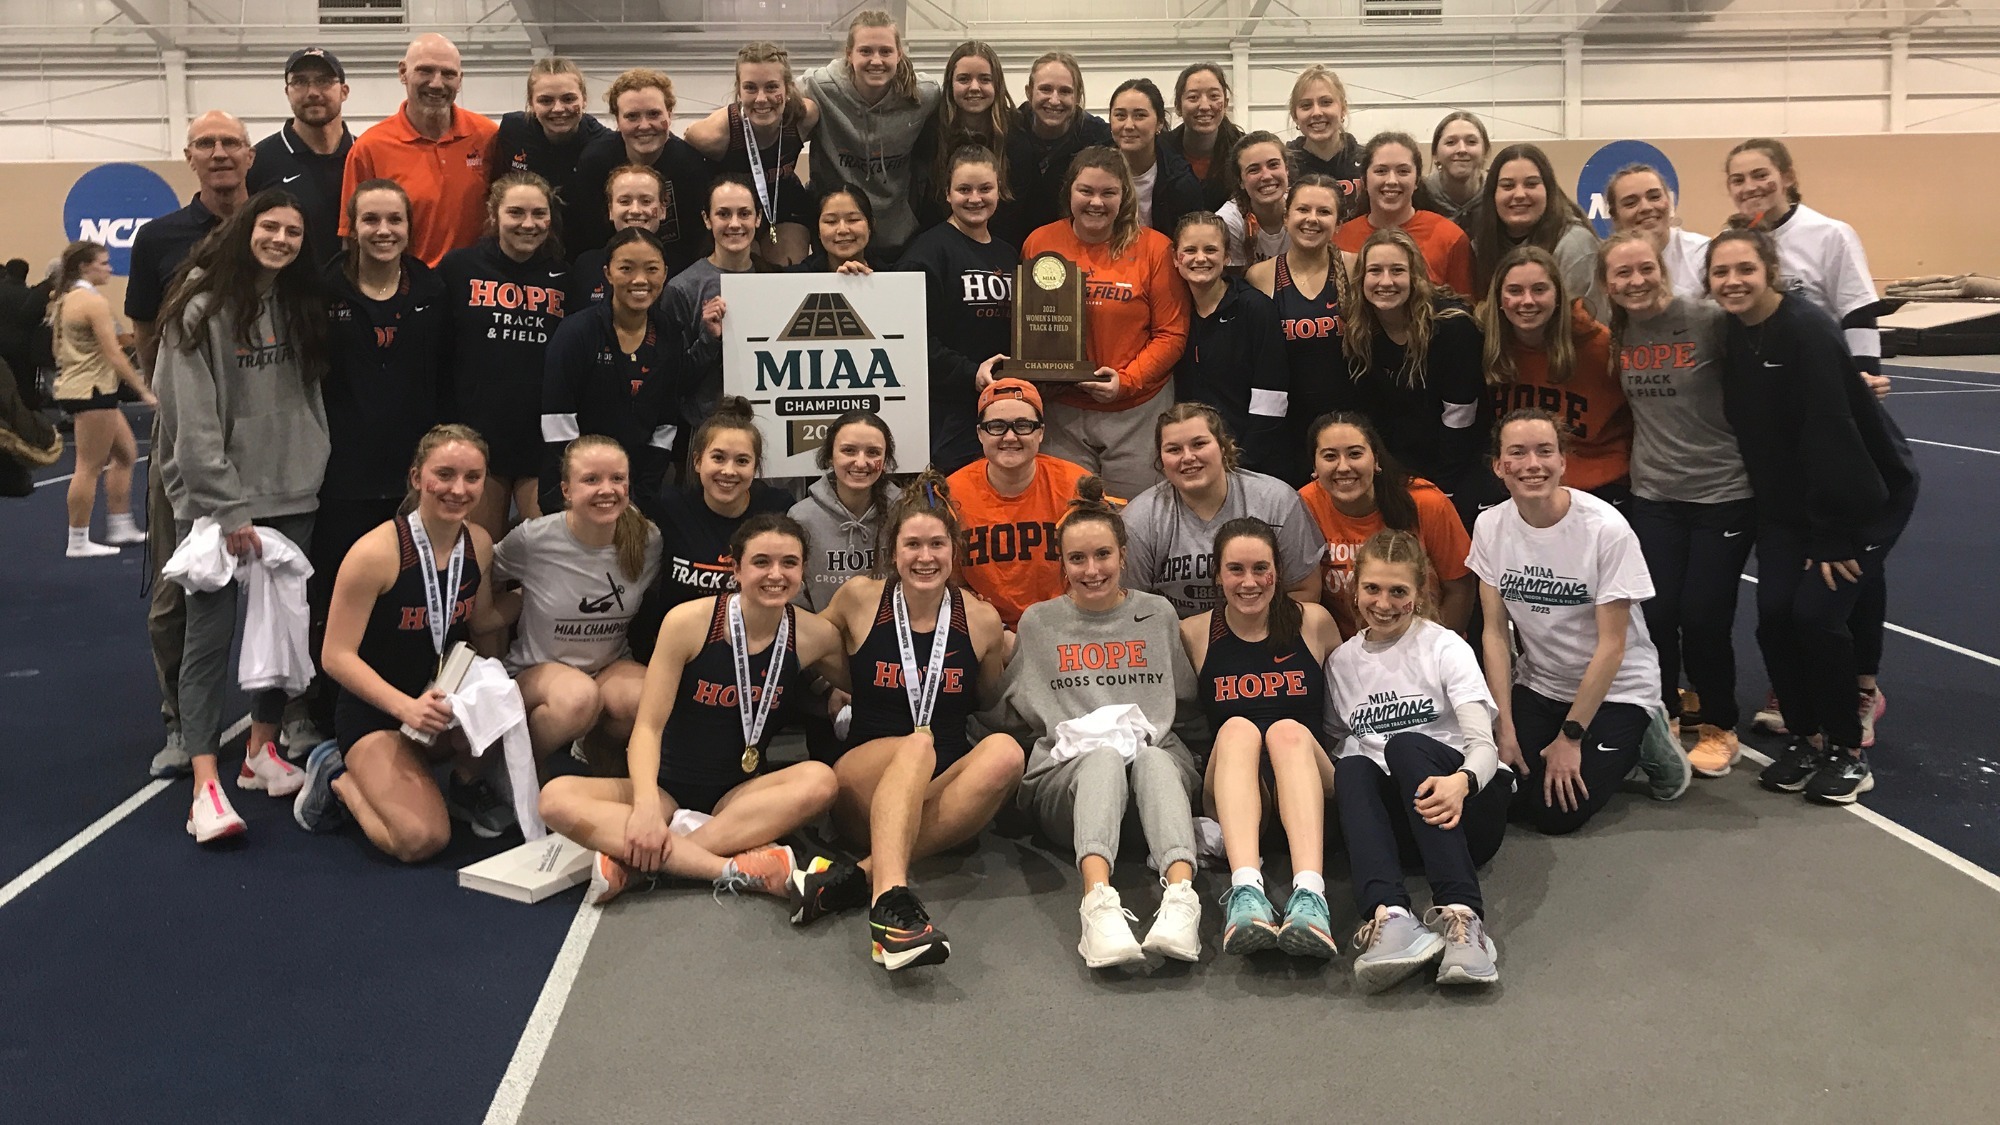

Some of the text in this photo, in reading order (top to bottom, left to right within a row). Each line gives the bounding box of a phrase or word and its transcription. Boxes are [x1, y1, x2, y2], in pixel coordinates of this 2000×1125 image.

[512, 160, 528, 170] HOPE
[961, 273, 1012, 301] HO
[1093, 286, 1132, 302] FIELD
[468, 279, 565, 318] HOPE
[1042, 305, 1056, 313] 2023
[492, 312, 545, 328] TRACK
[1025, 314, 1051, 322] WOMEN'S
[487, 328, 547, 343] & FIELD
[1053, 324, 1069, 332] FIELD
[754, 348, 901, 391] MIAA
[1024, 362, 1074, 370] CHAMPIONS
[1627, 374, 1671, 385] TRACK
[1637, 388, 1677, 397] FIELD
[784, 399, 870, 412] CHAMPIONS
[802, 424, 828, 441] 20
[672, 563, 737, 589] TRACK &
[1524, 565, 1553, 578] MIAA
[1500, 573, 1587, 596] CHAMPIONS
[1192, 587, 1214, 599] 186
[398, 594, 477, 630] HPE
[1530, 605, 1550, 614] 2023
[554, 624, 581, 635] MIAA
[1057, 640, 1147, 672] HOPE
[1050, 673, 1164, 690] CROSS COUNTRY
[1213, 670, 1307, 702] HOPE
[1368, 690, 1398, 705] MIAA
[1349, 698, 1434, 730] CHAMPIONS
[1412, 717, 1428, 725] FIELD
